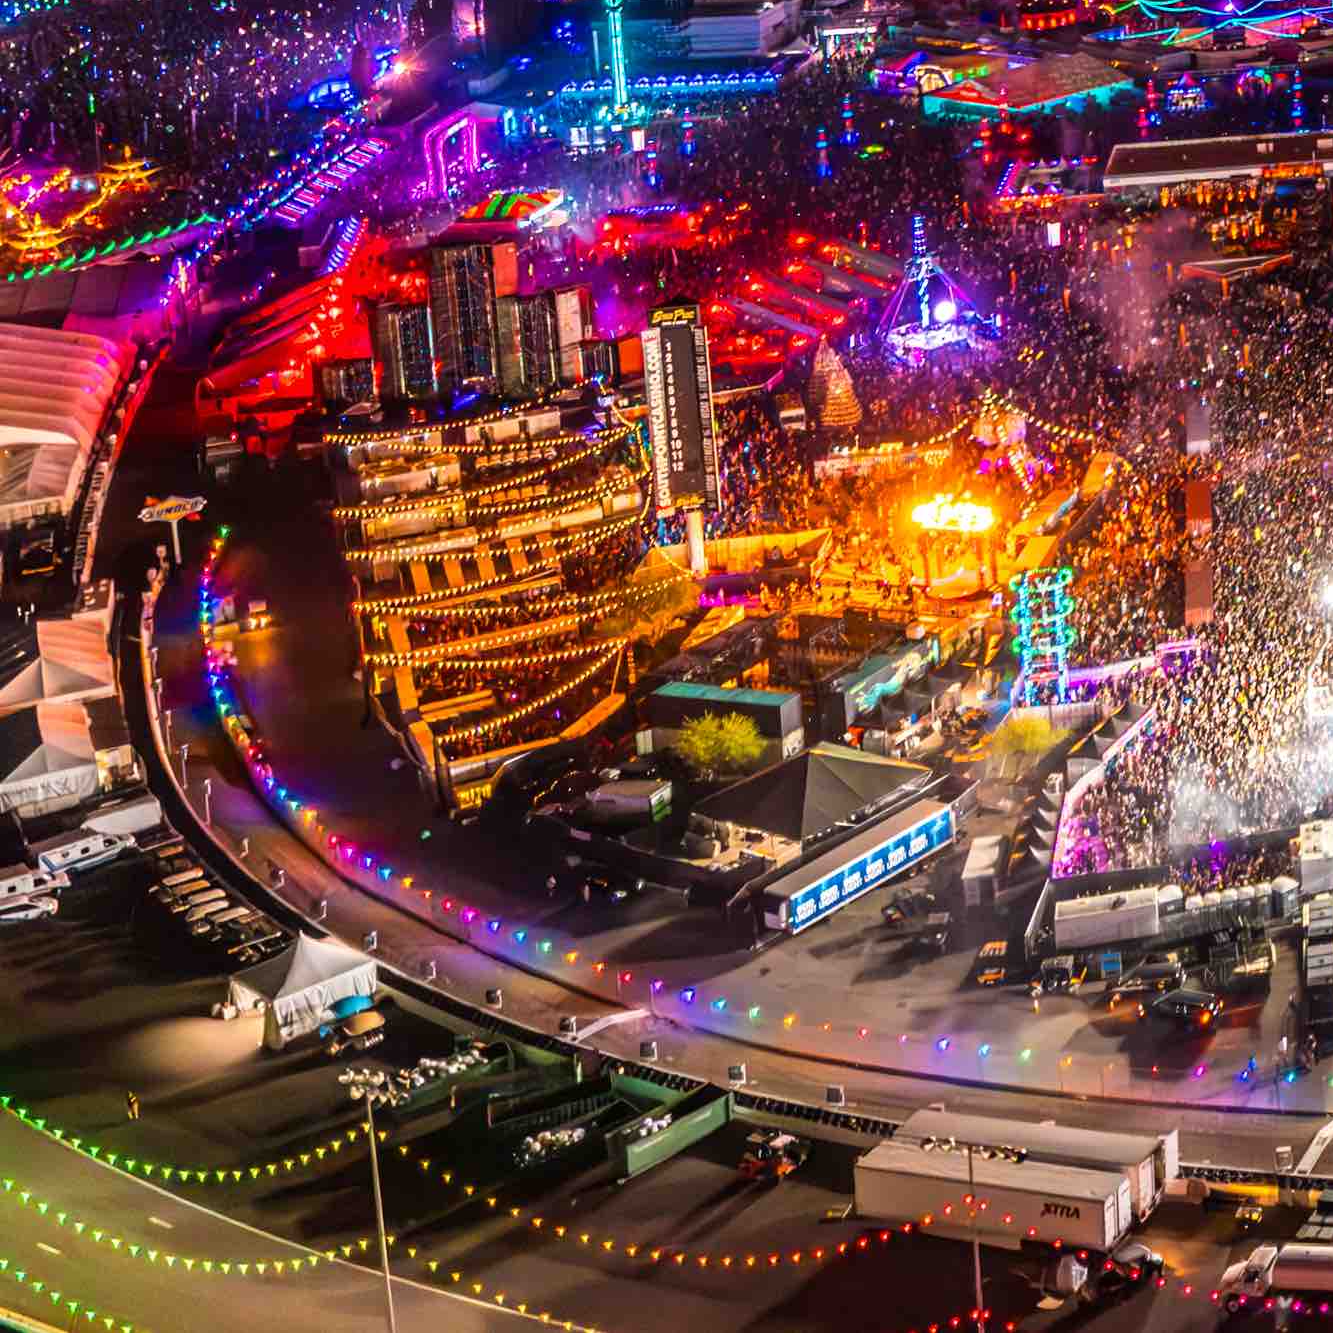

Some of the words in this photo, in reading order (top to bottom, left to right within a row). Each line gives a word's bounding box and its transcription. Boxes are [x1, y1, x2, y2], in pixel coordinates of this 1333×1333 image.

[665, 341, 672, 352] 1
[664, 352, 673, 363] 2
[666, 363, 674, 374] 3
[667, 374, 675, 384] 4
[668, 385, 675, 395] 5
[669, 396, 677, 406] 6
[670, 406, 677, 417] 7
[646, 341, 672, 507] SOUTHPOINTCASINO.COM
[670, 417, 678, 428] 8
[671, 428, 679, 439] 9
[670, 439, 683, 450] 10
[671, 450, 684, 461] 11
[672, 461, 685, 472] 12
[1040, 1202, 1080, 1219] XTRA
